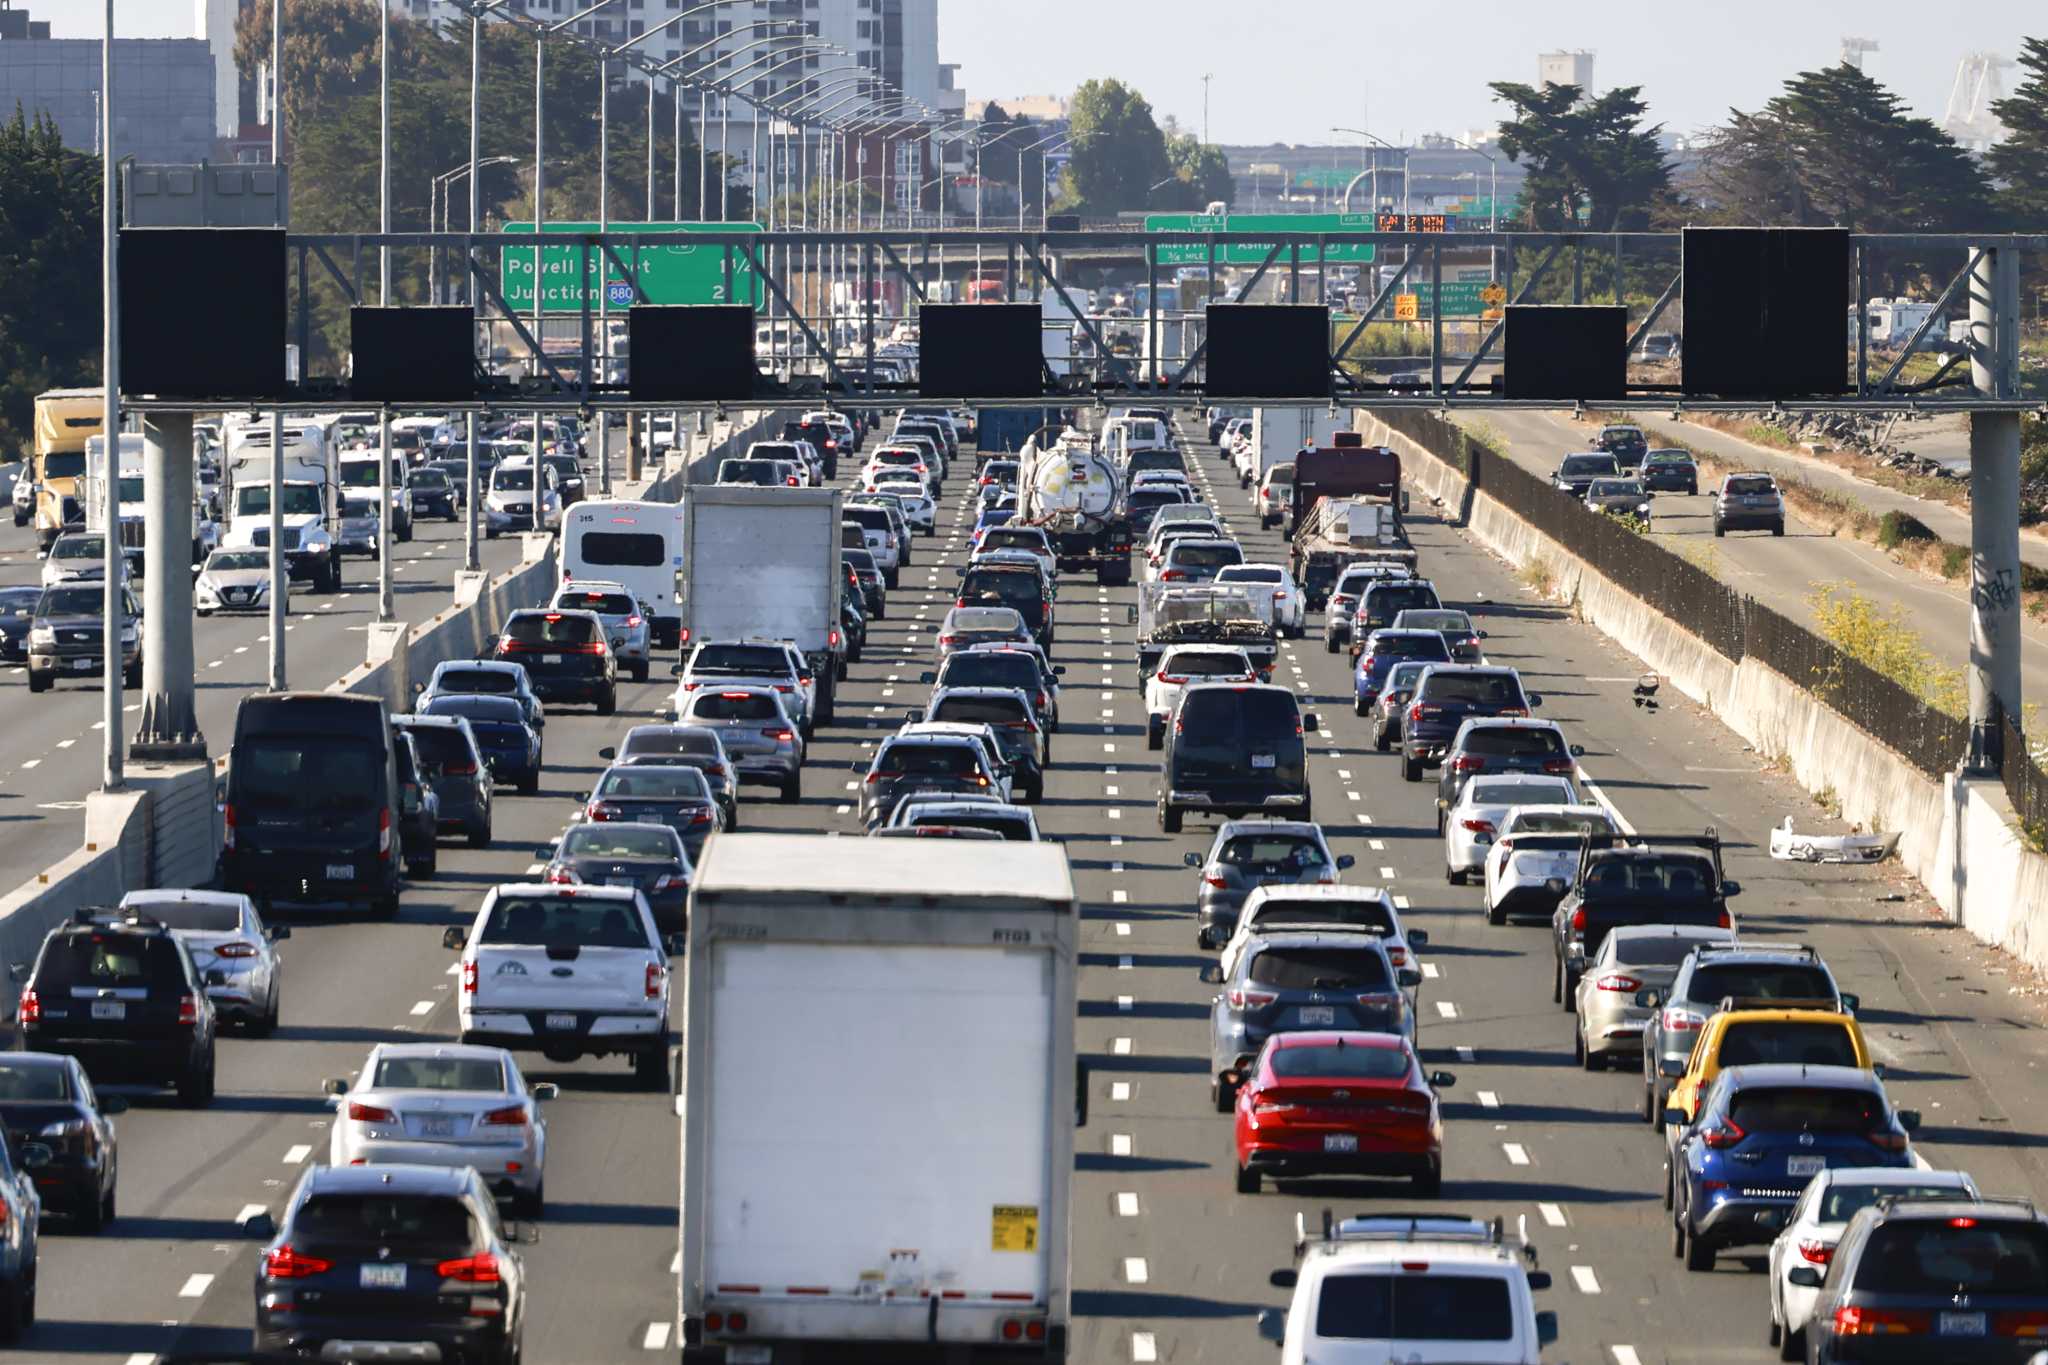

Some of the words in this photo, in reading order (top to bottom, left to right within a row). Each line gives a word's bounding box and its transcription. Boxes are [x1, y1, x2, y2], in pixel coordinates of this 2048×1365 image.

[610, 287, 633, 299] 880
[712, 285, 725, 300] 2
[1398, 306, 1413, 316] 40
